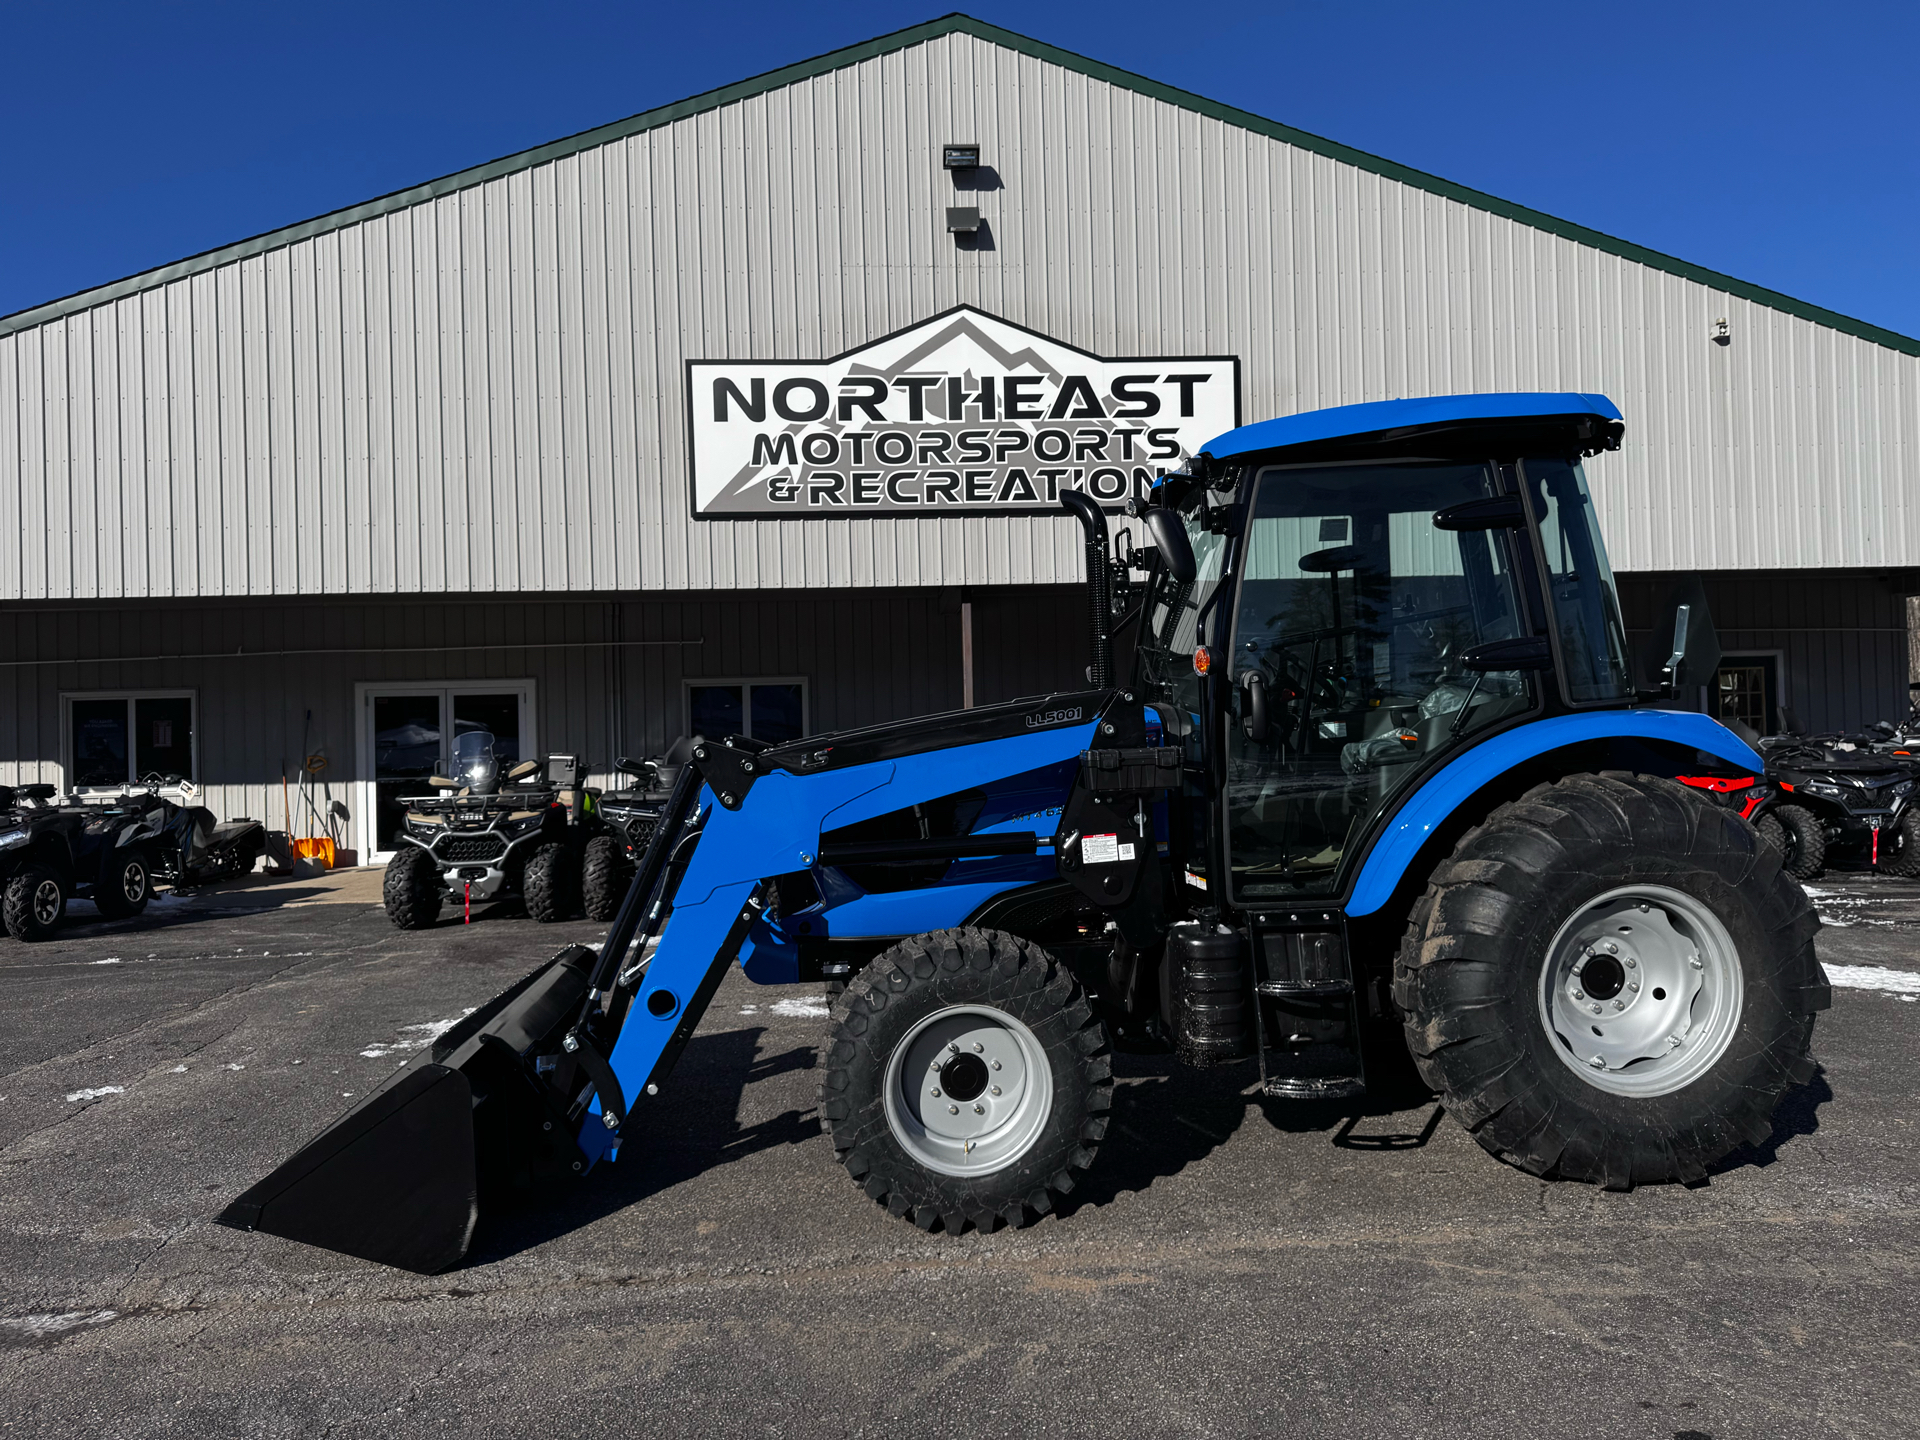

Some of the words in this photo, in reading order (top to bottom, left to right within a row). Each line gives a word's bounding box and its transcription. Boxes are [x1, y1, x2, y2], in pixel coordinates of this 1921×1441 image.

[713, 373, 1211, 423] NORTHEAST
[751, 427, 1181, 465] MOTORSPORTS
[1025, 706, 1083, 728] LL5001
[800, 746, 834, 769] LS
